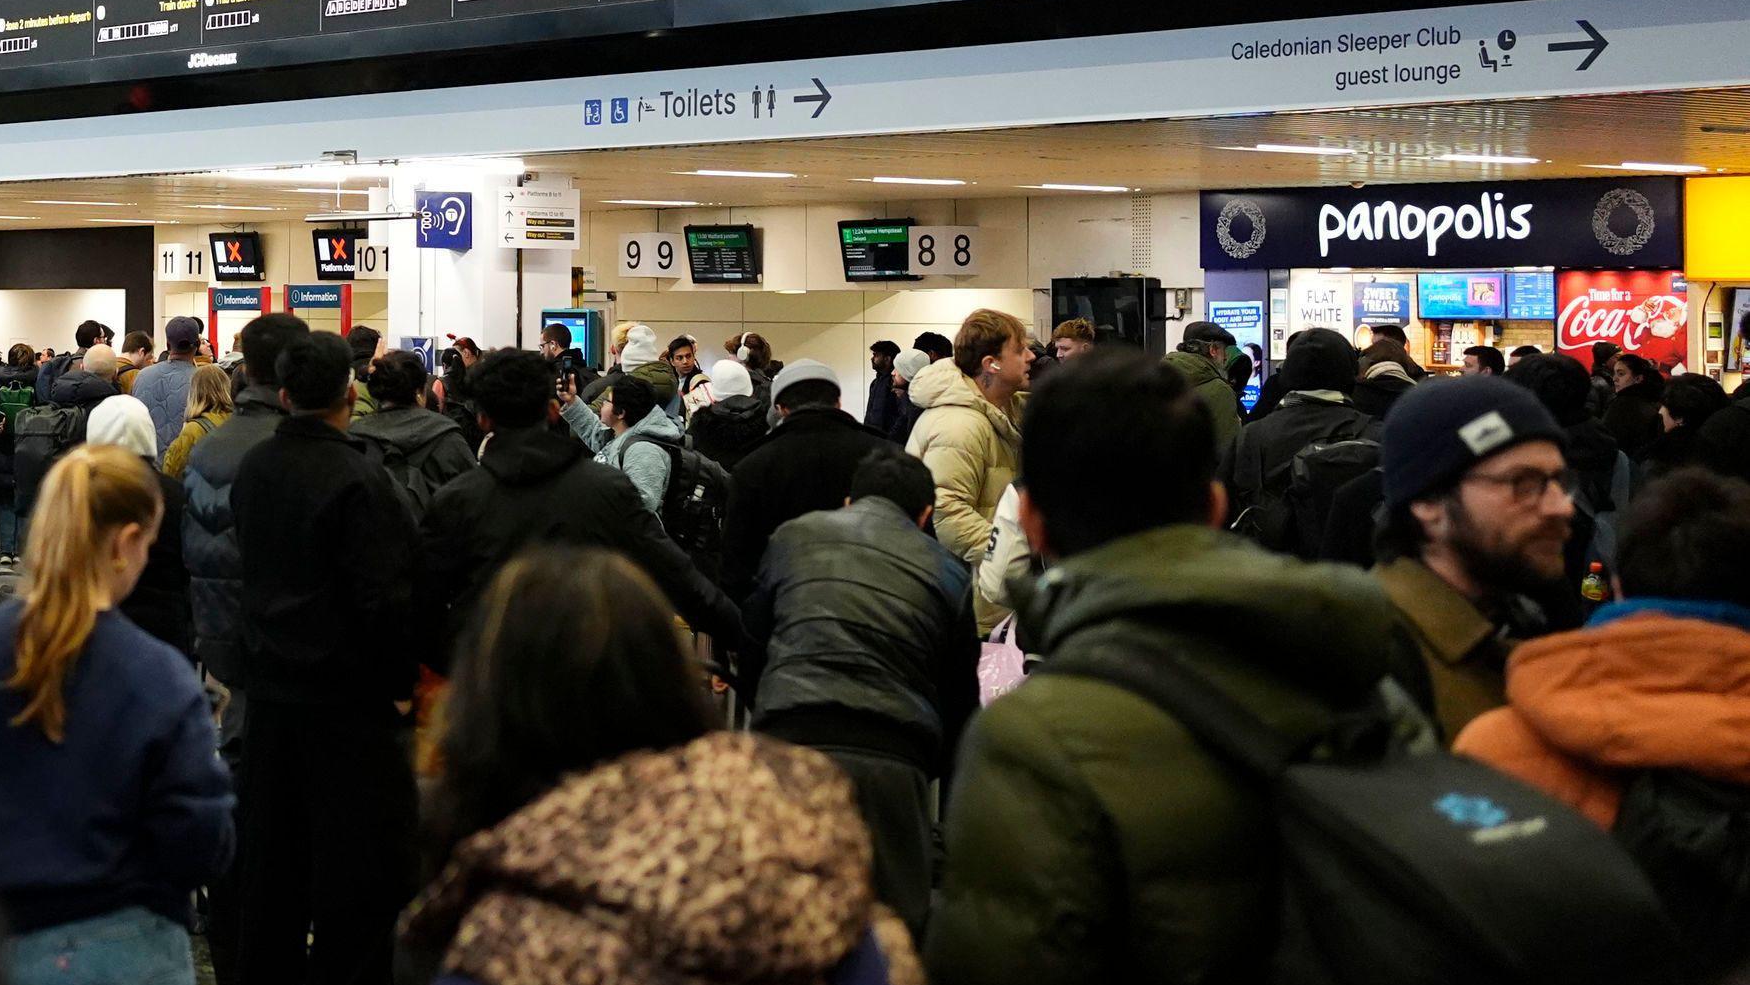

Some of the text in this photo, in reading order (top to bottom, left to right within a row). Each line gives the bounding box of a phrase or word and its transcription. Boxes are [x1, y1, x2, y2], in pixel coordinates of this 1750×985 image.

[1230, 25, 1460, 62] Caledonian Sleeper Club
[188, 53, 237, 68] JCDecaux
[1335, 61, 1461, 91] guest lounge
[658, 87, 737, 121] Toilets
[1319, 192, 1533, 257] panopolis
[163, 250, 174, 274] 11
[356, 246, 376, 273] 10
[626, 240, 641, 270] 9
[657, 240, 673, 270] 9
[918, 234, 935, 267] 8
[953, 234, 971, 267] 8
[185, 251, 202, 274] 11
[218, 265, 238, 274] Platform
[223, 295, 258, 305] Information
[300, 292, 337, 303] Information
[1307, 290, 1336, 304] FLAT
[1363, 287, 1398, 301] SWEET
[1589, 288, 1610, 302] Time
[1611, 288, 1623, 302] for
[1301, 308, 1342, 323] WHITE
[1362, 299, 1400, 313] TREATS
